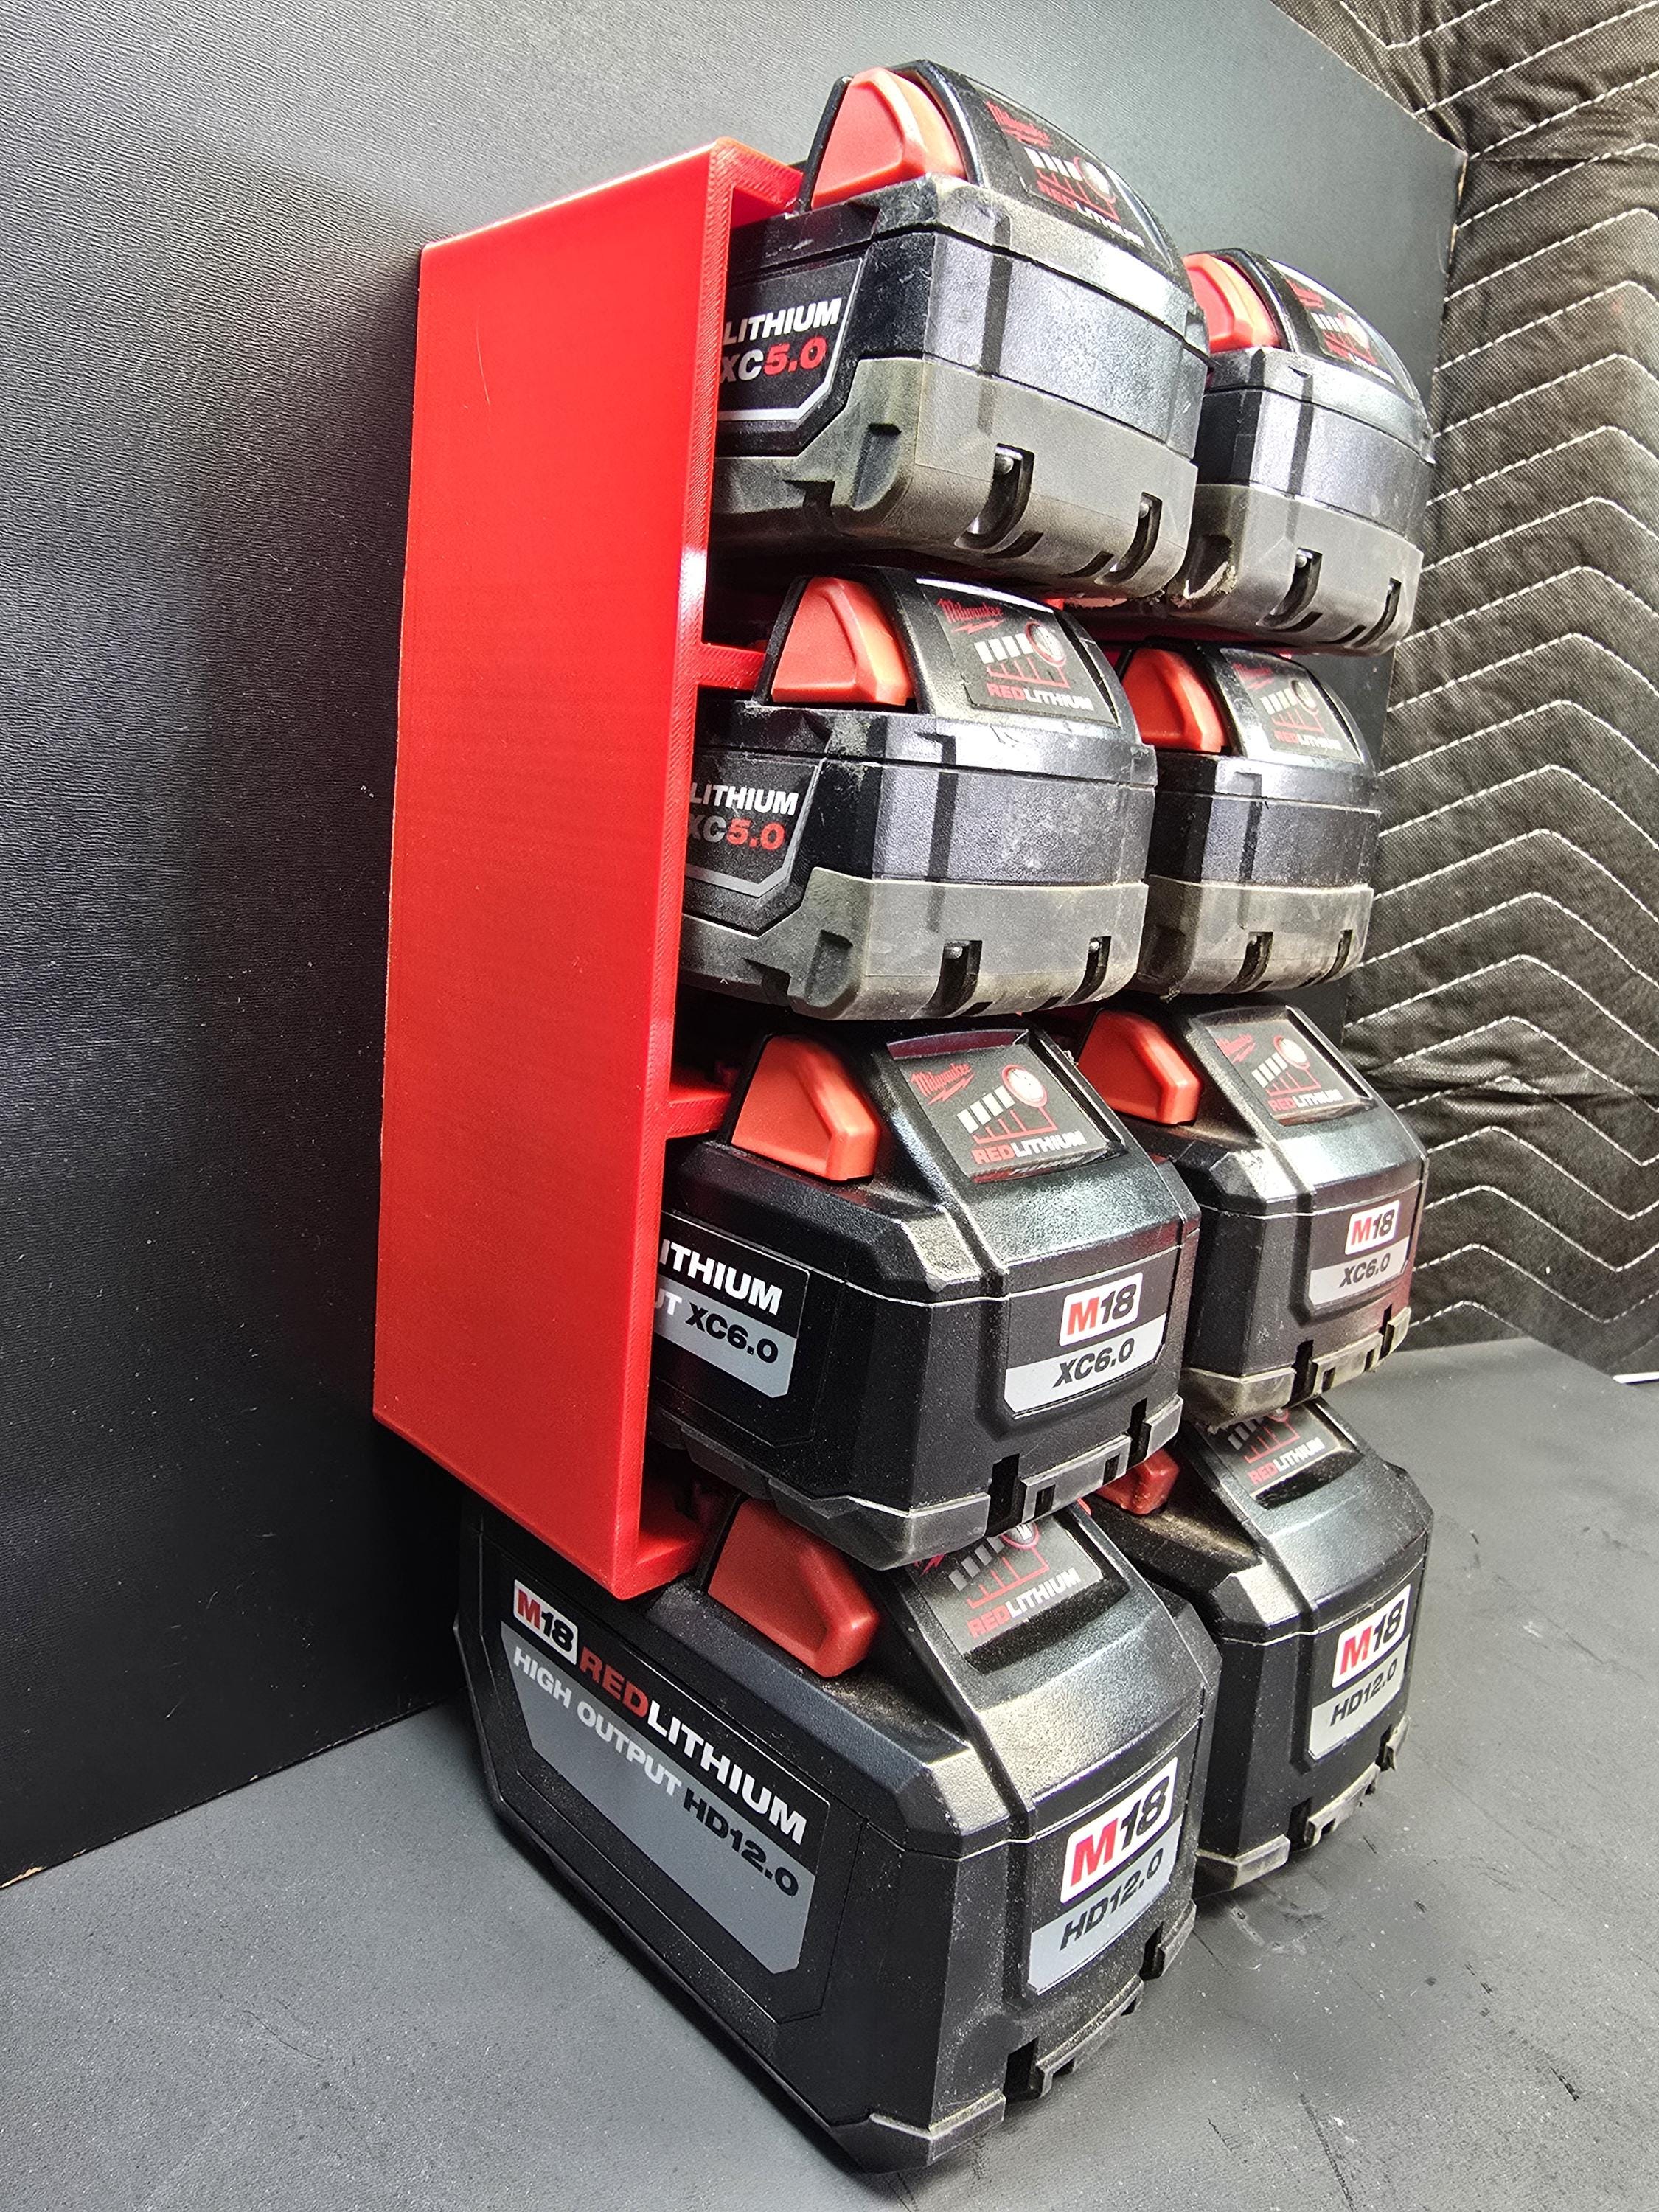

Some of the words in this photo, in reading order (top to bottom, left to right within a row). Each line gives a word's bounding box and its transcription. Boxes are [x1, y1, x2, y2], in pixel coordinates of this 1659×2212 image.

[722, 297, 842, 346] LITHIUM
[719, 335, 827, 383] XC5.0
[986, 682, 1094, 711] REDLITHIUM
[690, 782, 799, 815] LITHIUM
[971, 1130, 1087, 1165] REDLITHIUM
[1351, 1209, 1395, 1245] M18
[1339, 1252, 1391, 1288] XC6.0
[685, 1302, 779, 1363] XC6.0
[1067, 1284, 1137, 1335] M18
[1051, 1338, 1135, 1388] XC6.0
[967, 1567, 1081, 1639] REDLITHIUM
[1340, 1599, 1405, 1675] M18
[518, 1589, 574, 1652] M18
[579, 1646, 807, 1846] REDLITHIUM
[1329, 1658, 1398, 1726] HD12.0
[514, 1646, 572, 1708] HIGH
[577, 1701, 682, 1796] OUTPUT
[683, 1787, 799, 1896] HD12.0
[1070, 1775, 1169, 1887] M18
[1060, 1848, 1164, 1951] HD12.0
